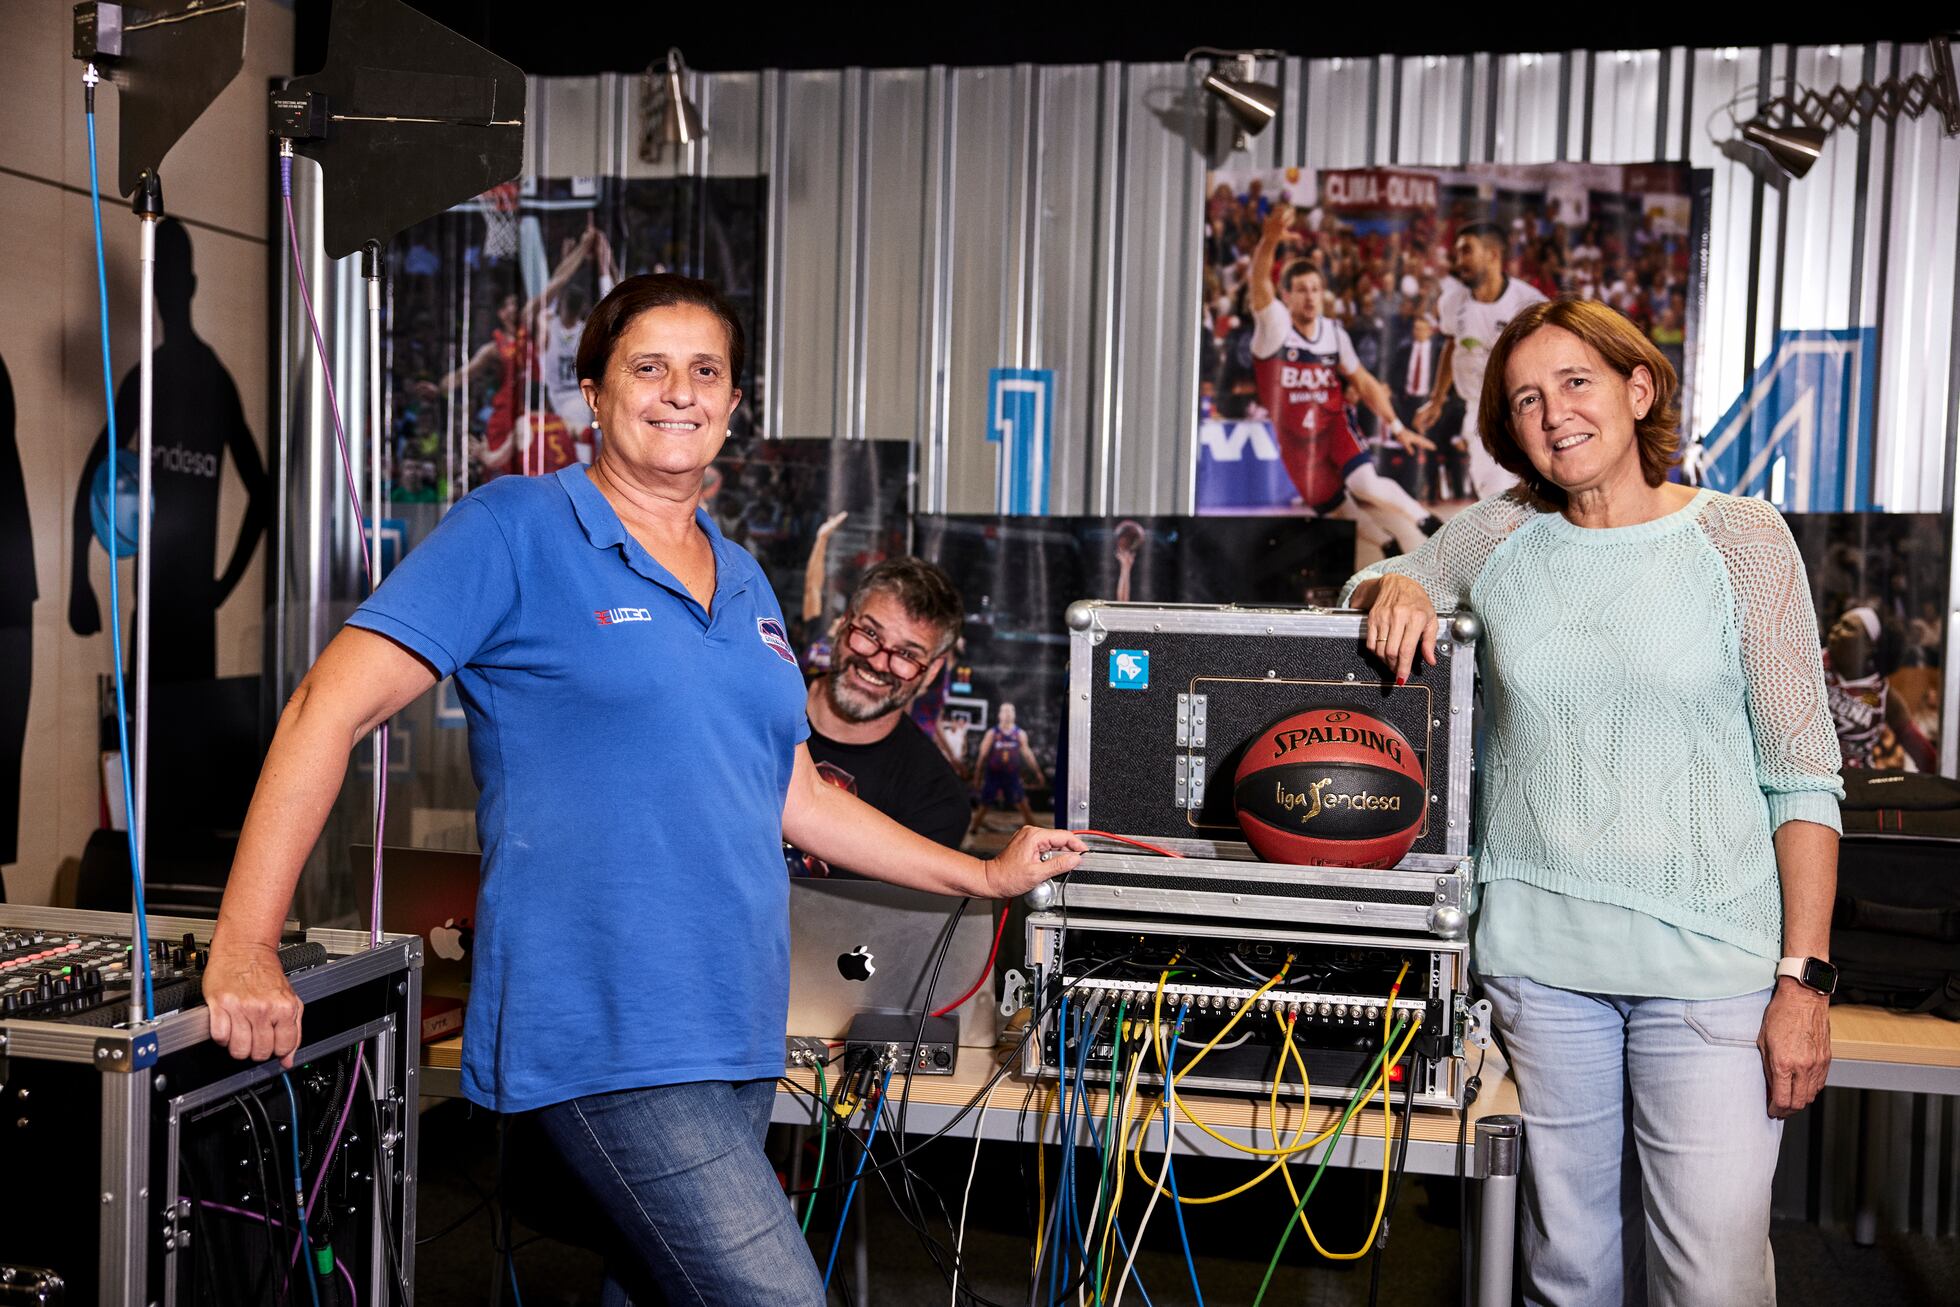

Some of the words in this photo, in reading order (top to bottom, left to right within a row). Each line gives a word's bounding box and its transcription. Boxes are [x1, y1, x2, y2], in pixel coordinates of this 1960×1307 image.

[151, 442, 217, 477] ndesa
[984, 368, 1054, 515] 1
[1274, 727, 1403, 765] SPALDING
[1276, 781, 1308, 811] liga
[1323, 791, 1401, 811] endesa
